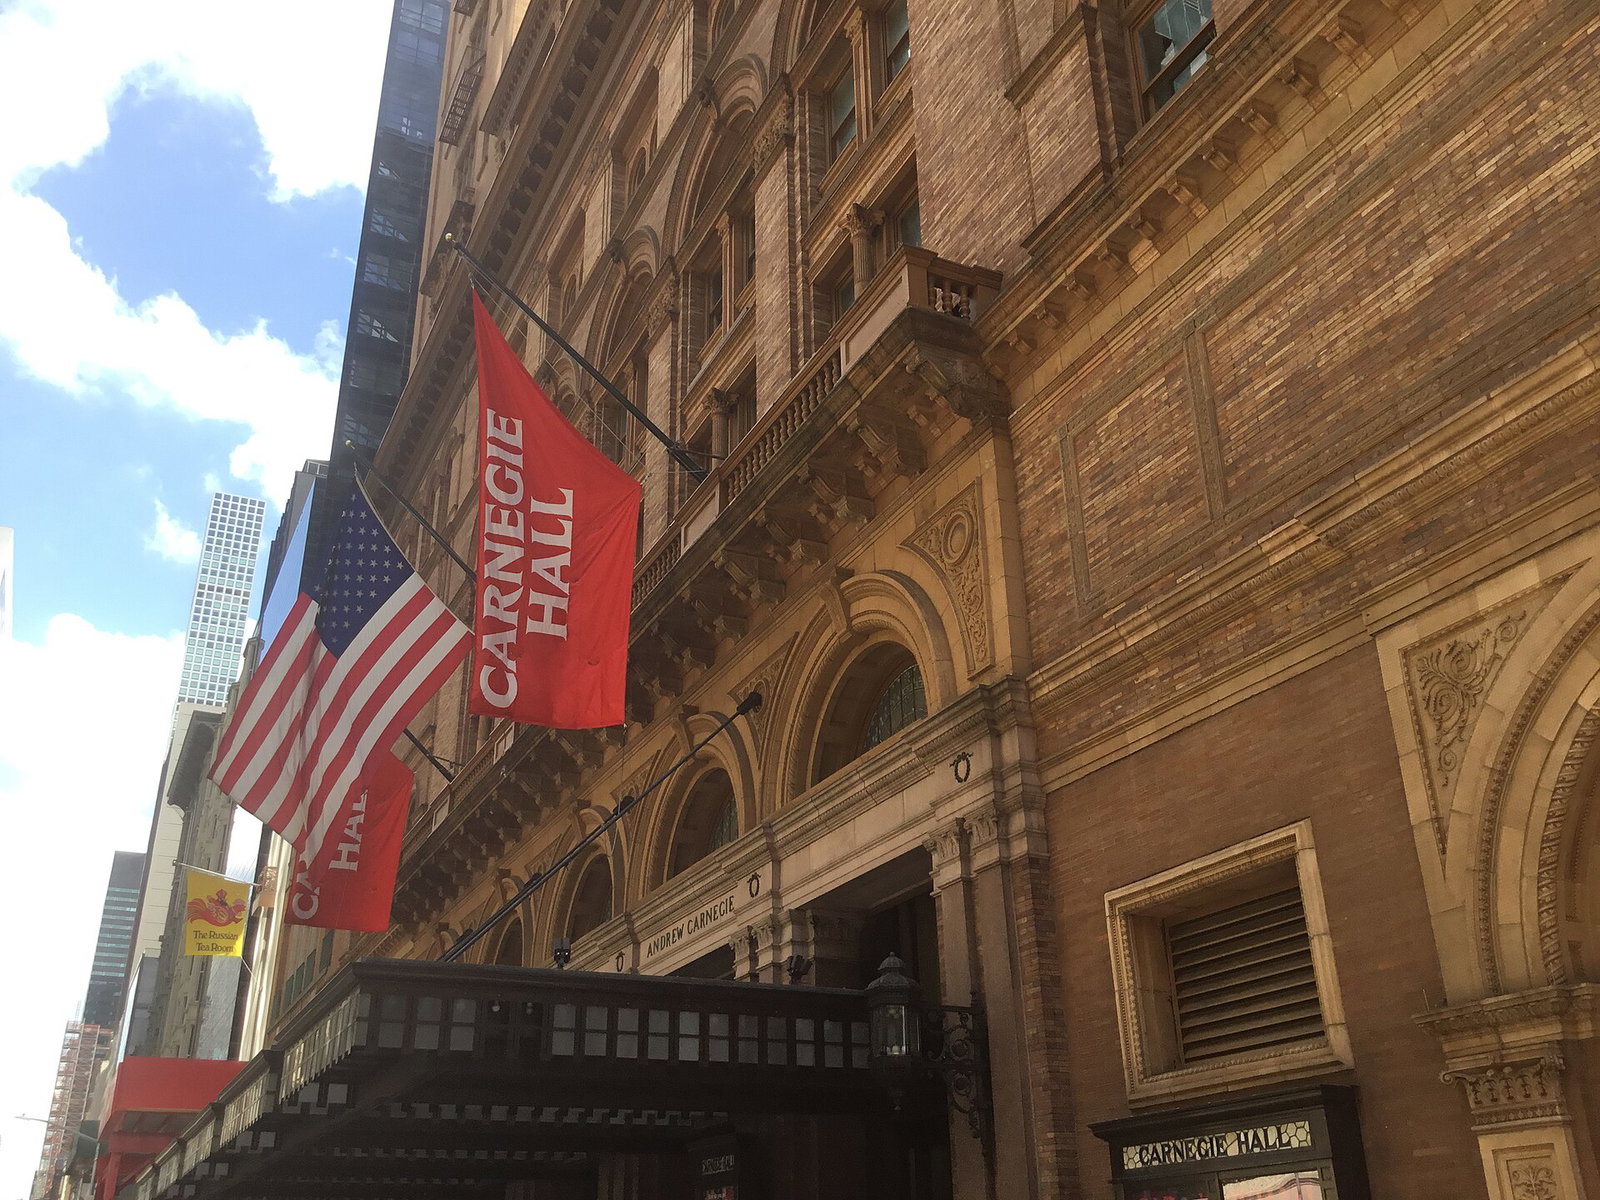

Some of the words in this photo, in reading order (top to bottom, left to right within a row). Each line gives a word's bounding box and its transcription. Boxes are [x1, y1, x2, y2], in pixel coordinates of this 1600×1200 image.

[479, 407, 525, 709] CARNEGIE
[525, 487, 574, 641] HALL
[328, 789, 368, 872] HAL
[193, 930, 207, 940] The
[208, 930, 239, 941] Russian
[196, 942, 210, 952] Tea
[211, 942, 234, 953] Room
[646, 923, 685, 958] ANDREW
[687, 895, 735, 935] CARNEGIE
[1138, 1133, 1227, 1166] CARNEGIE
[1236, 1124, 1291, 1156] HALL
